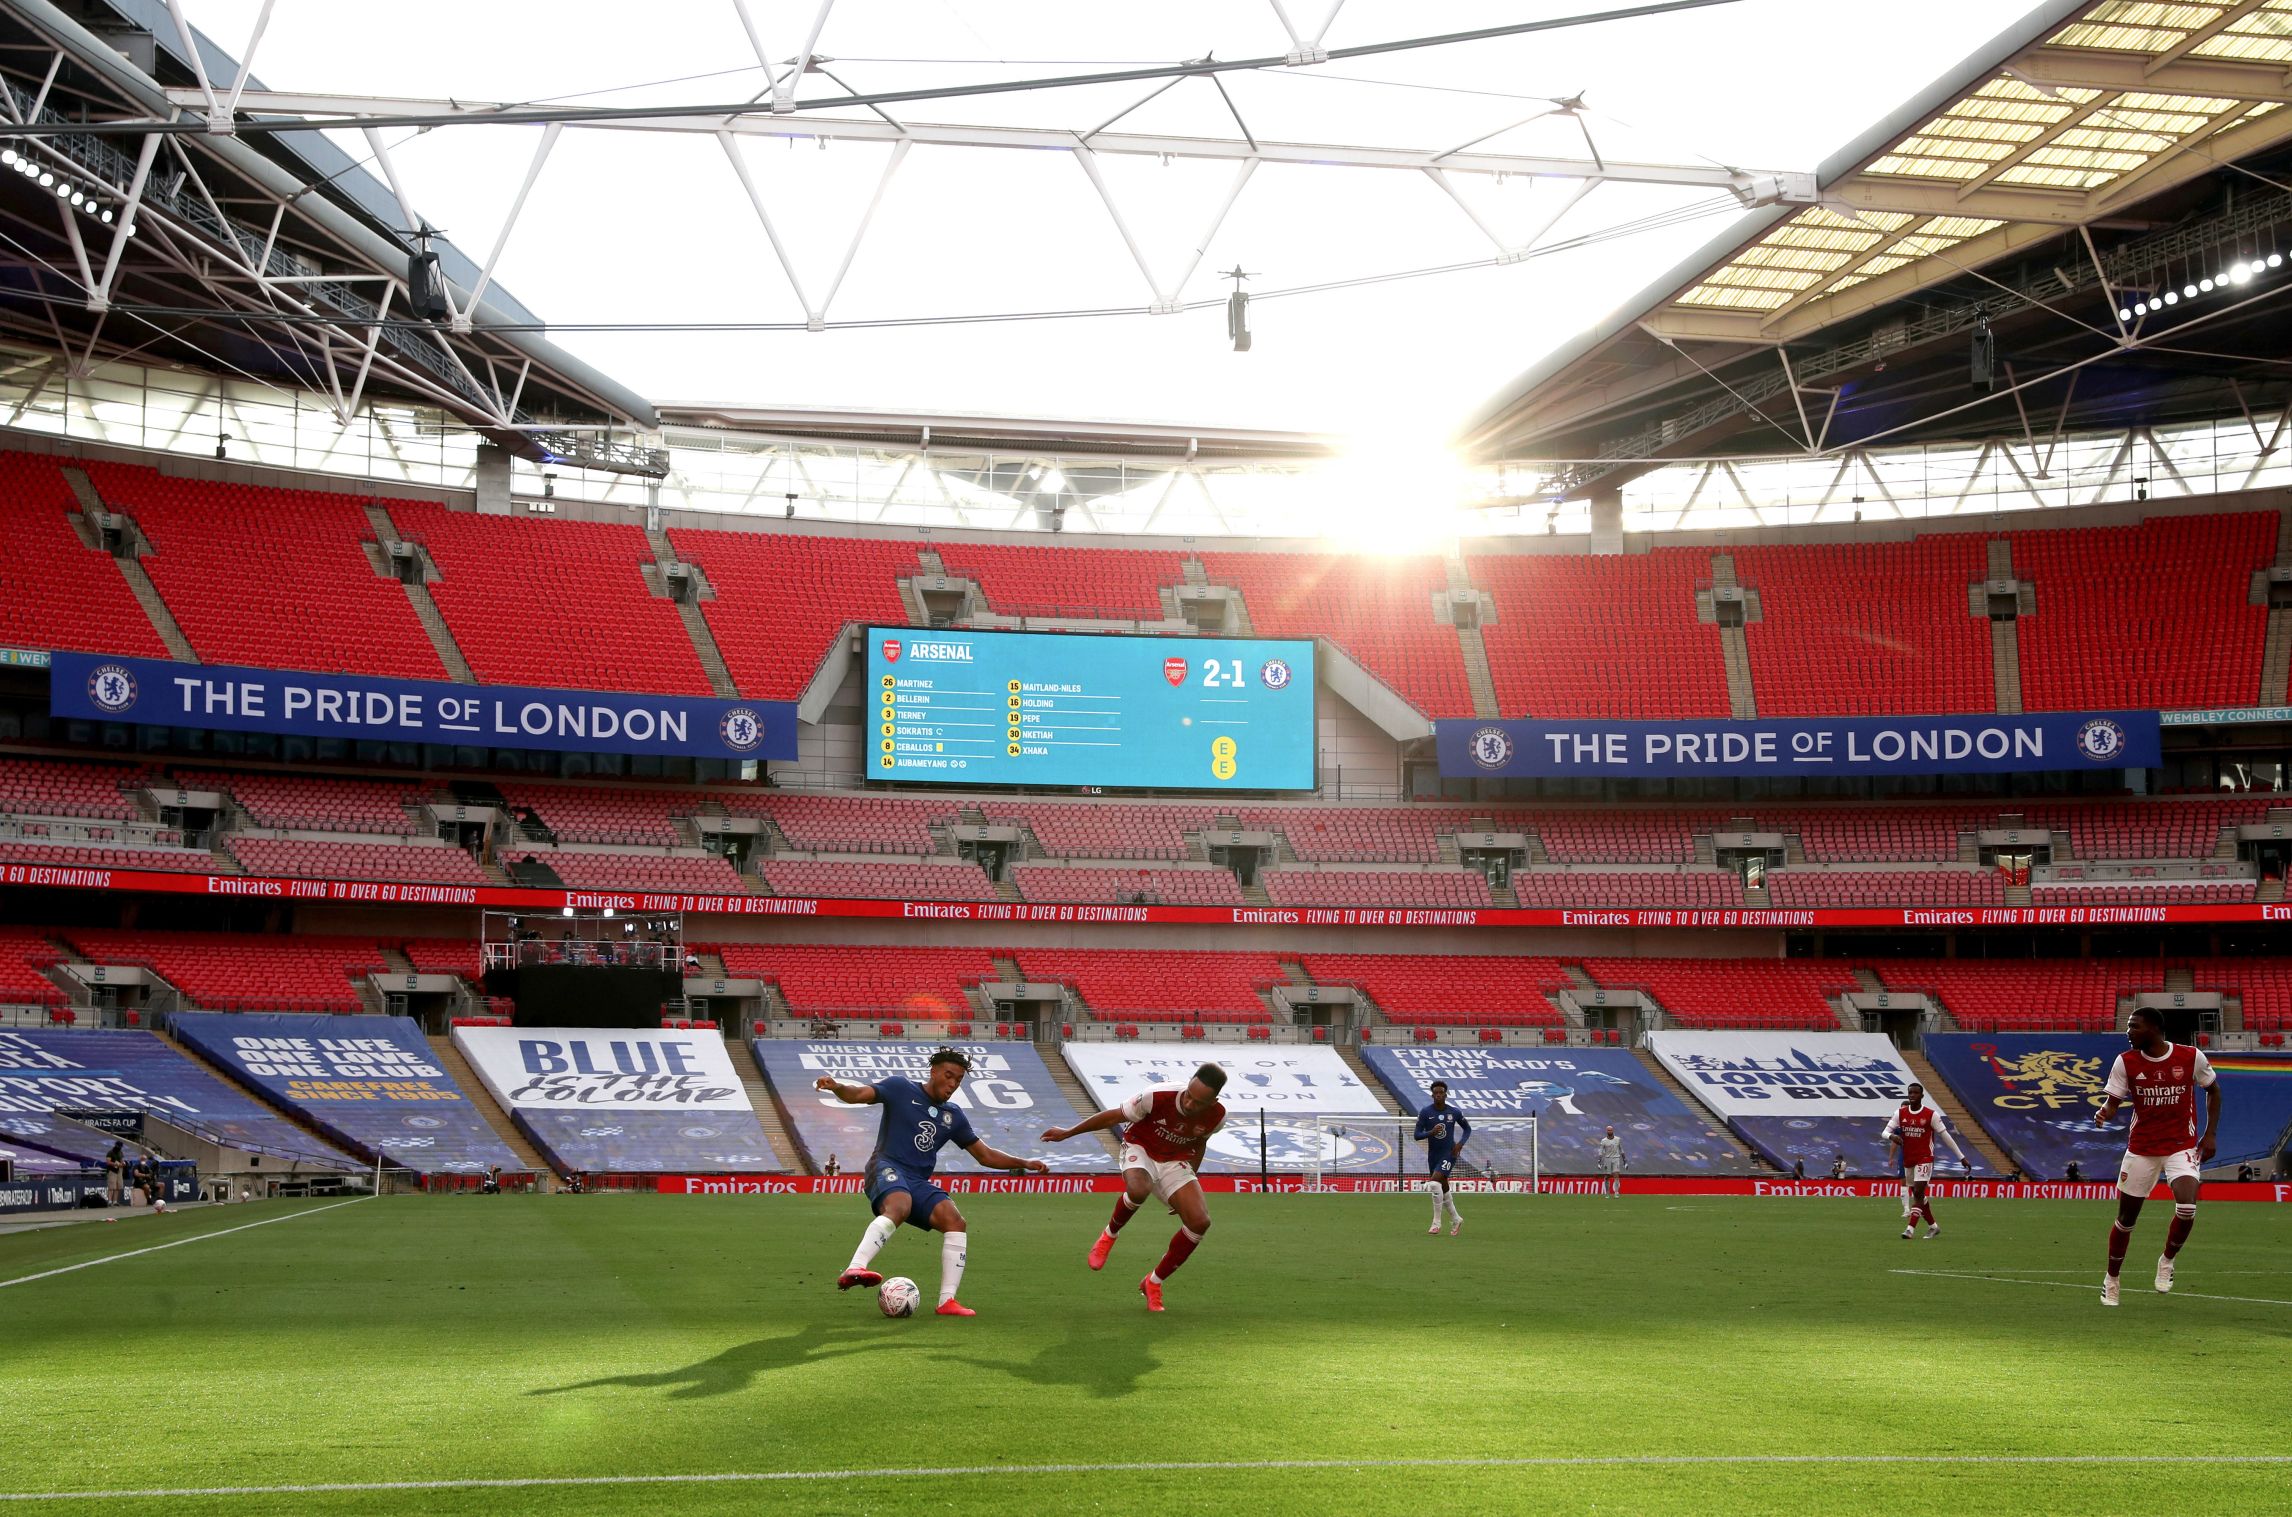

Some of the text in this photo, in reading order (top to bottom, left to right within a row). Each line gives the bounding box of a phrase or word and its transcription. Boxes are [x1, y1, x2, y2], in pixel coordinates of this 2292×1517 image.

[910, 644, 974, 660] ARSENAL
[96, 666, 129, 679] CHELSEA
[1203, 658, 1246, 687] 2-1
[883, 678, 933, 688] 26 MARTINEZ
[1010, 682, 1081, 693] 15 MAITLAND-NILES
[885, 694, 930, 704] 2 BELLERIN
[1010, 698, 1054, 708] 16 HOLDING
[174, 677, 687, 742] THE PRIDE OF LONDON
[727, 708, 757, 720] CHELSEA
[885, 710, 926, 720] 3 TIERNEY
[1010, 714, 1040, 723] 19 PEPE
[2161, 712, 2225, 723] WEMBLEY
[885, 726, 933, 736] 5 SOKRATIS
[2085, 719, 2116, 731] CHELSEA
[1010, 730, 1053, 740] 30 NKETIAH
[1476, 728, 1506, 740] CHELSEA
[885, 742, 933, 752] 8 CEBALLOS
[1010, 746, 1048, 755] 34 XHAKA
[1545, 728, 2044, 764] THE PRIDE OF LONDON
[883, 758, 947, 768] 14 AUBAMEYANG
[10, 868, 24, 883] 60
[29, 869, 112, 888] DESTINATIONS
[208, 876, 476, 903] Emirates FLYING TO OVER 60 DESTINATIONS
[566, 892, 817, 914] Emirates FLYING TO OVER 60 DESTINATIONS
[903, 903, 1148, 922] Emirates FLYING TO OVER 60 DESTINATIONS
[1232, 908, 1477, 925] Emirates FLYING TO OVER 60 DESTINATIONS
[1563, 911, 1814, 925] Emirates FLYING TO OVER 60 DESTINATIONS
[1903, 907, 2166, 924] Emirates FLYING TO OVER 60 DESTINATIONS
[232, 1037, 401, 1051] ONE LIFE
[807, 1045, 875, 1054] WHEN
[877, 1045, 913, 1054] WE
[957, 1046, 988, 1054] TO
[237, 1050, 425, 1064] ONE LOVE
[519, 1040, 706, 1076] BLUE
[1391, 1049, 1495, 1060] FRANK
[811, 1055, 990, 1068] WEMBY
[1254, 1059, 1301, 1068] OF
[1399, 1059, 1577, 1070] LAMPARD'S
[245, 1063, 444, 1078] ONE CLUB
[824, 1070, 998, 1079] YOU'LL HE US
[1407, 1069, 1489, 1079] BLUE
[593, 1074, 709, 1091] THE
[1695, 1072, 1906, 1086] LONDON
[288, 1081, 437, 1091] CAREFREE
[2135, 1084, 2186, 1096] Emirates
[285, 1090, 461, 1100] SINCE 1905
[508, 1086, 737, 1104] COLOUR
[813, 1078, 1034, 1109] SG
[1220, 1092, 1317, 1100] NDON
[1422, 1089, 1532, 1100] WHITE
[1722, 1086, 1909, 1100] IS BLUE
[1993, 1095, 2133, 1110] CFC
[1221, 1156, 1318, 1168] FOOBALL
[1441, 1159, 1451, 1171] 20
[685, 1177, 798, 1194] Emirates
[951, 1179, 970, 1193] 60
[980, 1179, 1094, 1194] DESTINATIONS
[1754, 1180, 2118, 1200] Emirates FLYI TO OVER 60 DESTINATION
